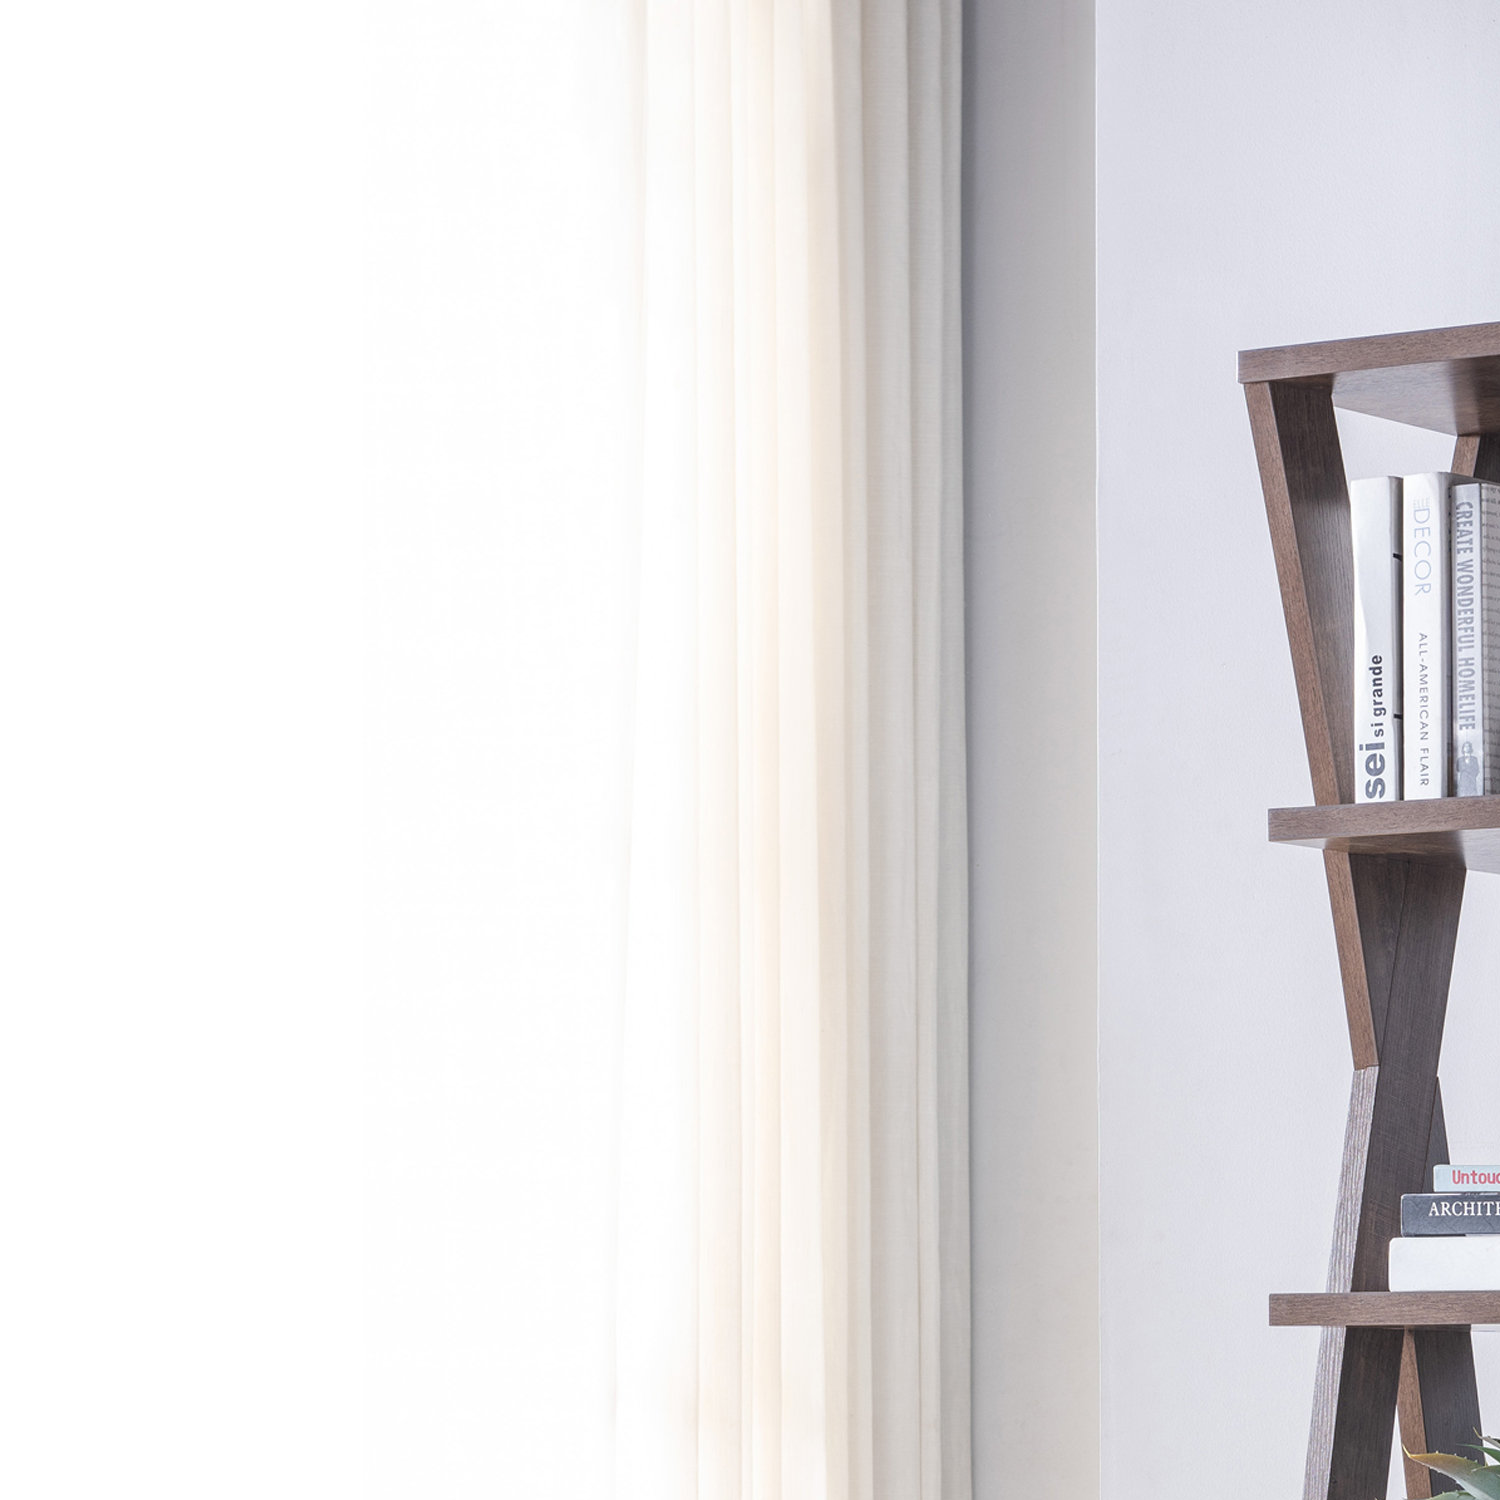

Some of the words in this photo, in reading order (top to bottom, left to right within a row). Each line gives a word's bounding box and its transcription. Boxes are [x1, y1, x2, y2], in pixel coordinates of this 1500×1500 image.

[1413, 507, 1432, 596] DECOR
[1456, 501, 1473, 555] CREATE
[1456, 558, 1474, 652] WONDERFUL
[1369, 654, 1386, 717] grande
[1418, 632, 1430, 741] ALL-AMERICAN
[1458, 656, 1475, 731] HOMELIFE
[1373, 723, 1385, 737] si
[1359, 742, 1385, 799] sei
[1419, 746, 1430, 786] FLAIR
